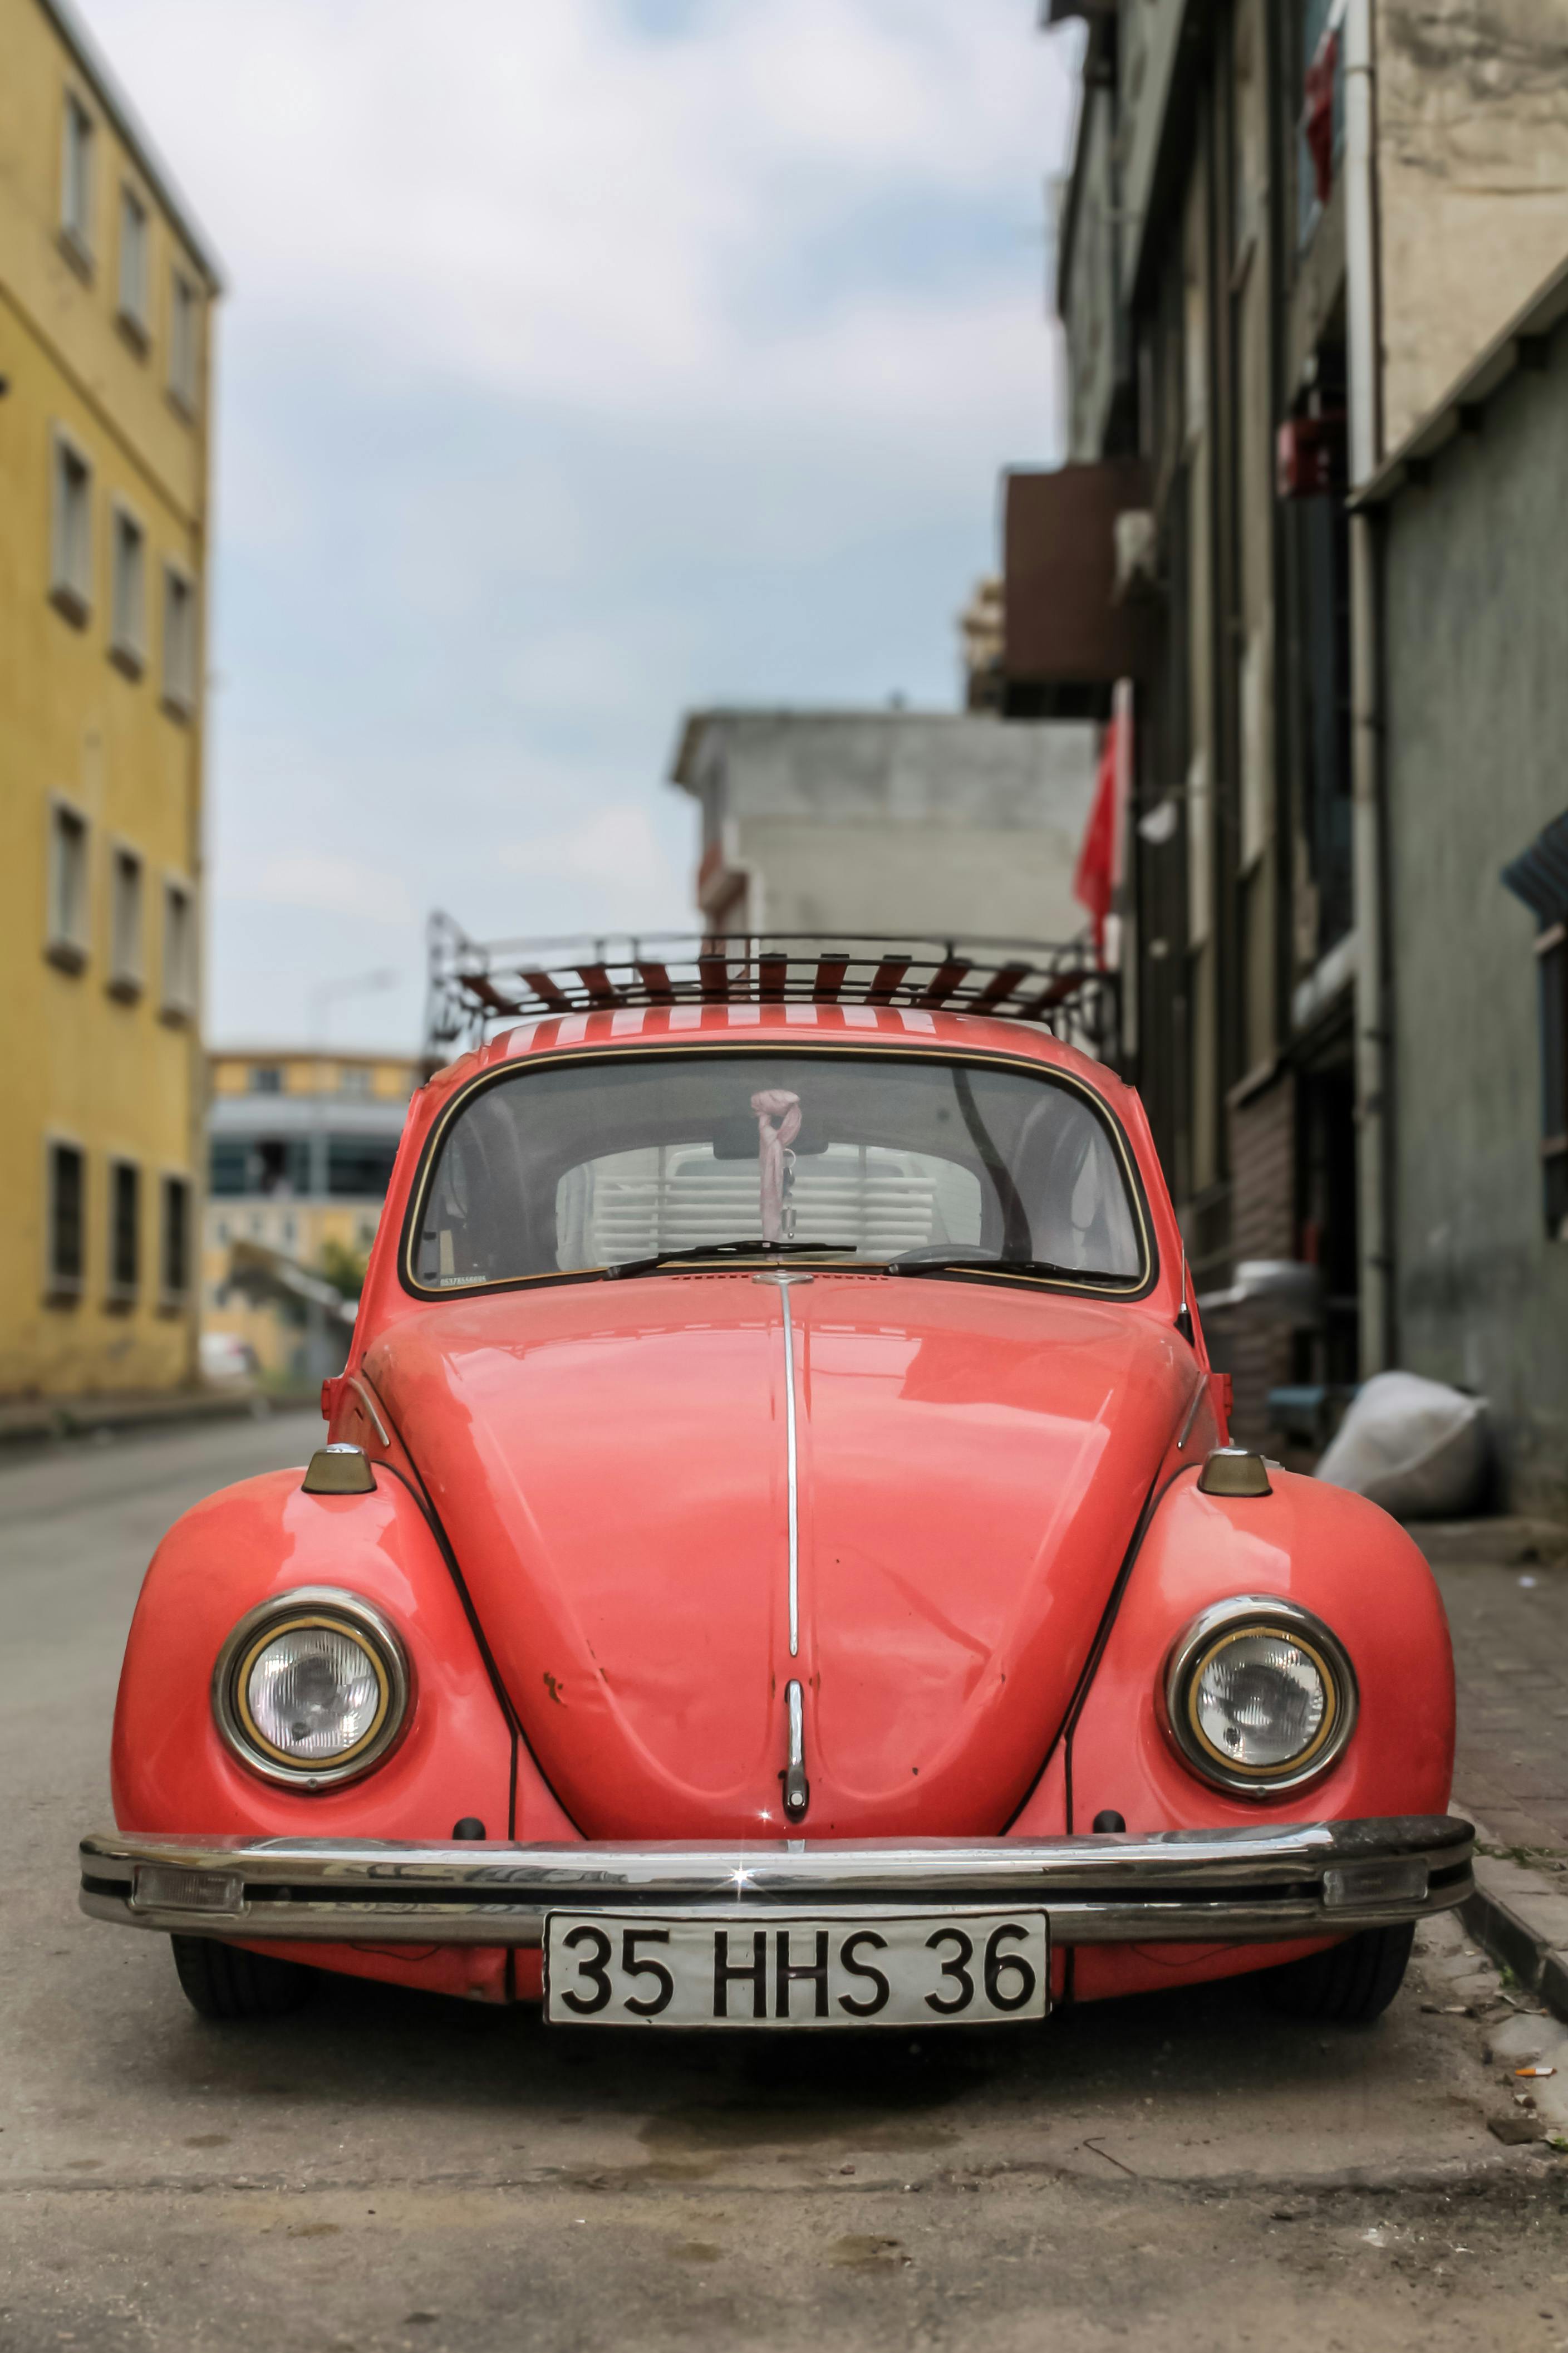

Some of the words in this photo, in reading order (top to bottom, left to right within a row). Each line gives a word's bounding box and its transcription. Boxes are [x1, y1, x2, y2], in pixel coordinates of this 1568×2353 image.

[560, 1925, 675, 2018] 35
[712, 1930, 891, 2019] HHS
[924, 1923, 1036, 2016] 36
